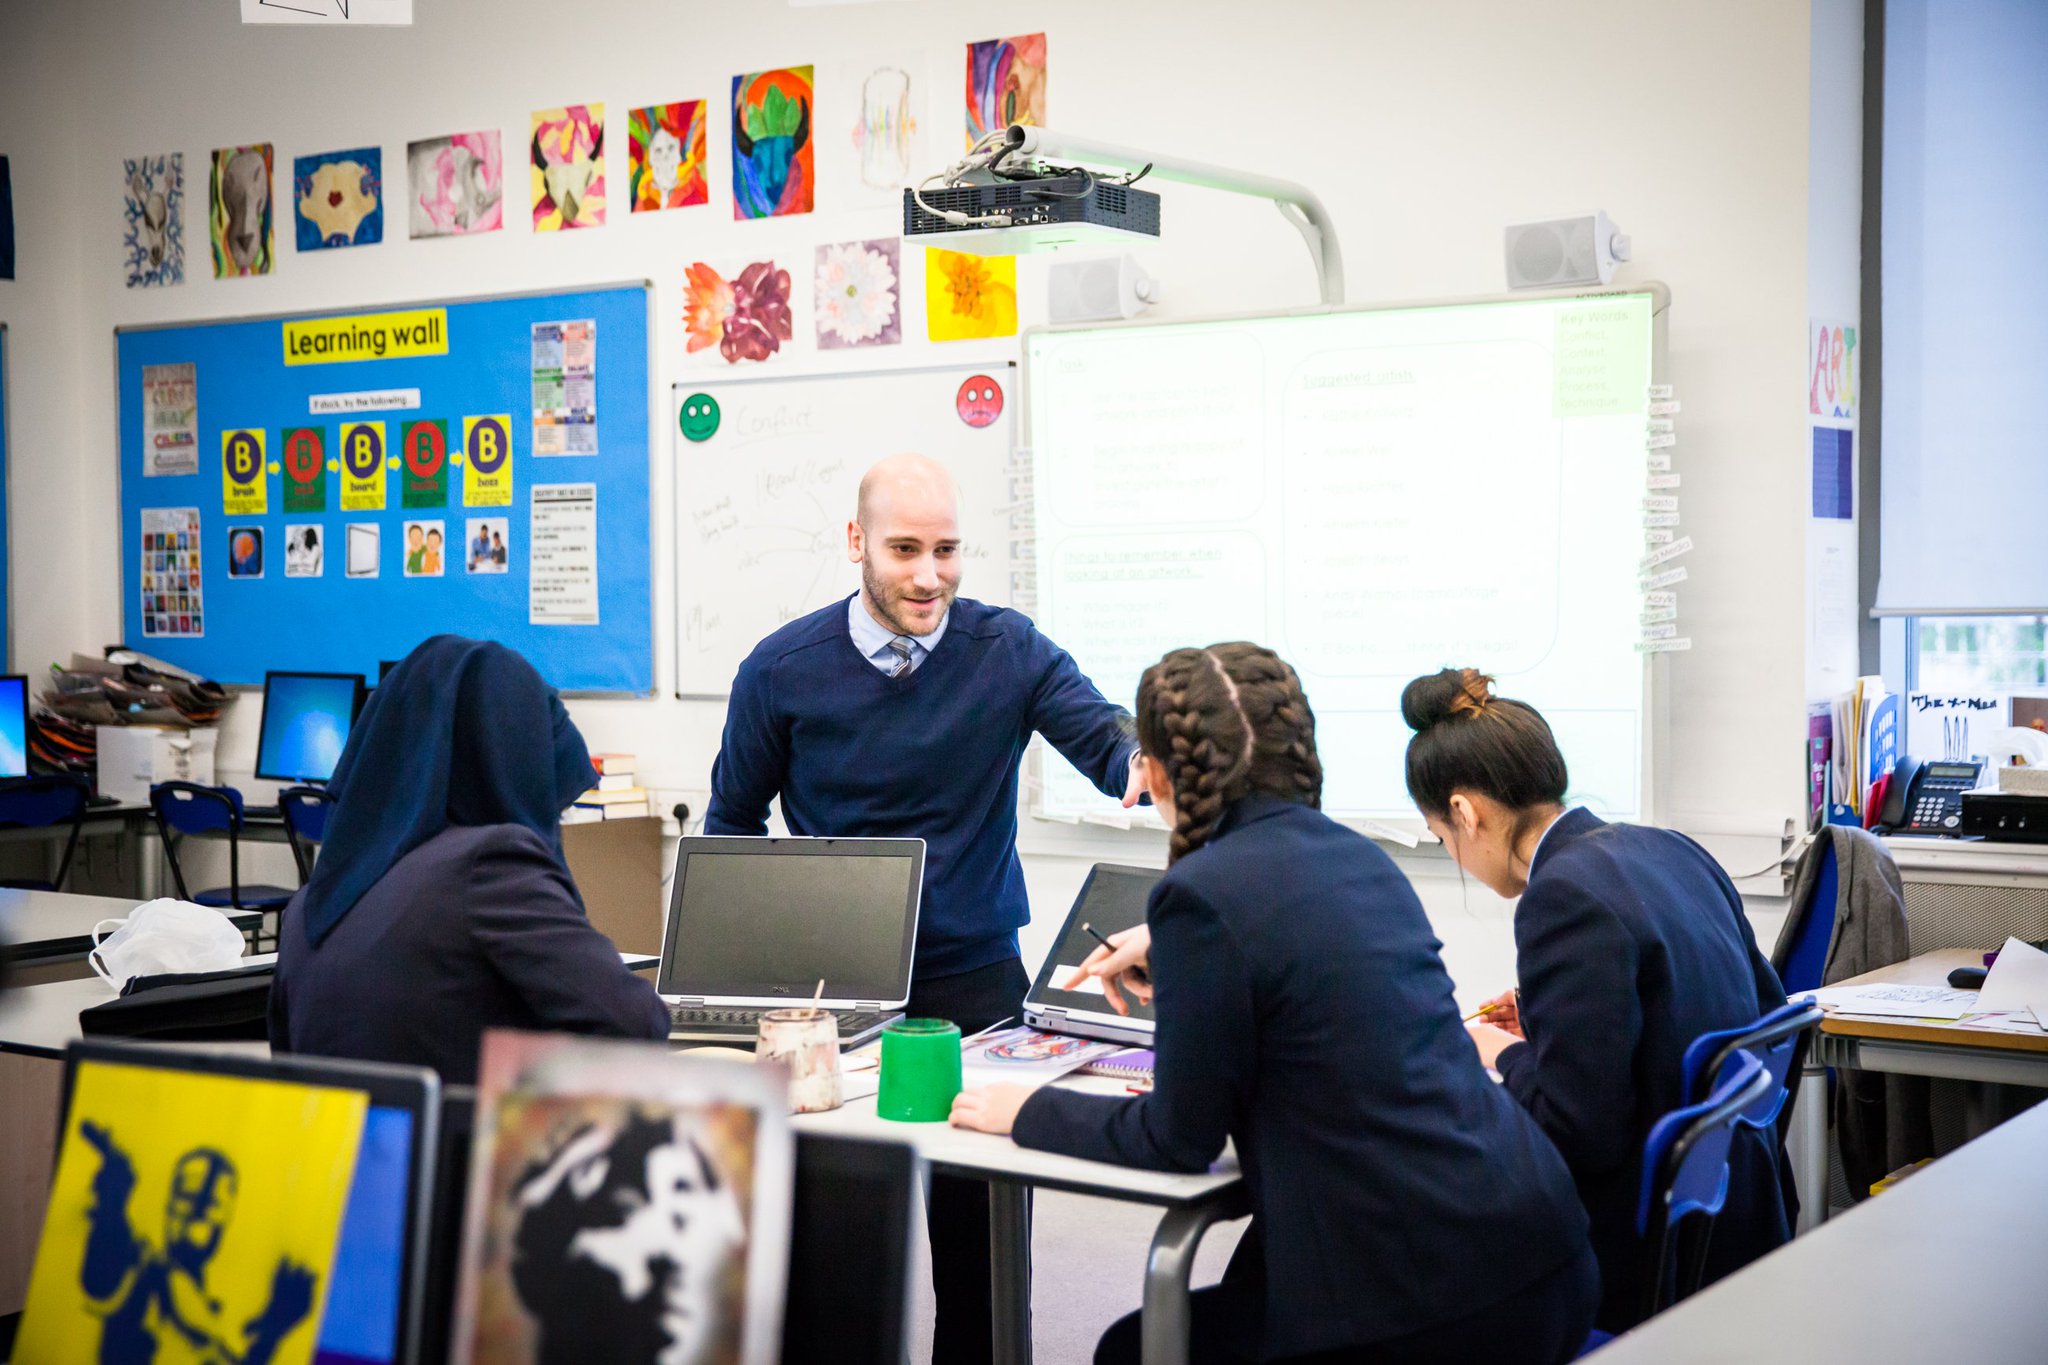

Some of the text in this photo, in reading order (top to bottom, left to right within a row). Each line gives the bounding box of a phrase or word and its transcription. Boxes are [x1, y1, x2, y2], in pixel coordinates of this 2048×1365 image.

[289, 317, 440, 357] Learning wall
[235, 440, 252, 474] B
[297, 438, 313, 471] B
[355, 433, 373, 469] B
[417, 431, 434, 465] B
[479, 427, 498, 463] B
